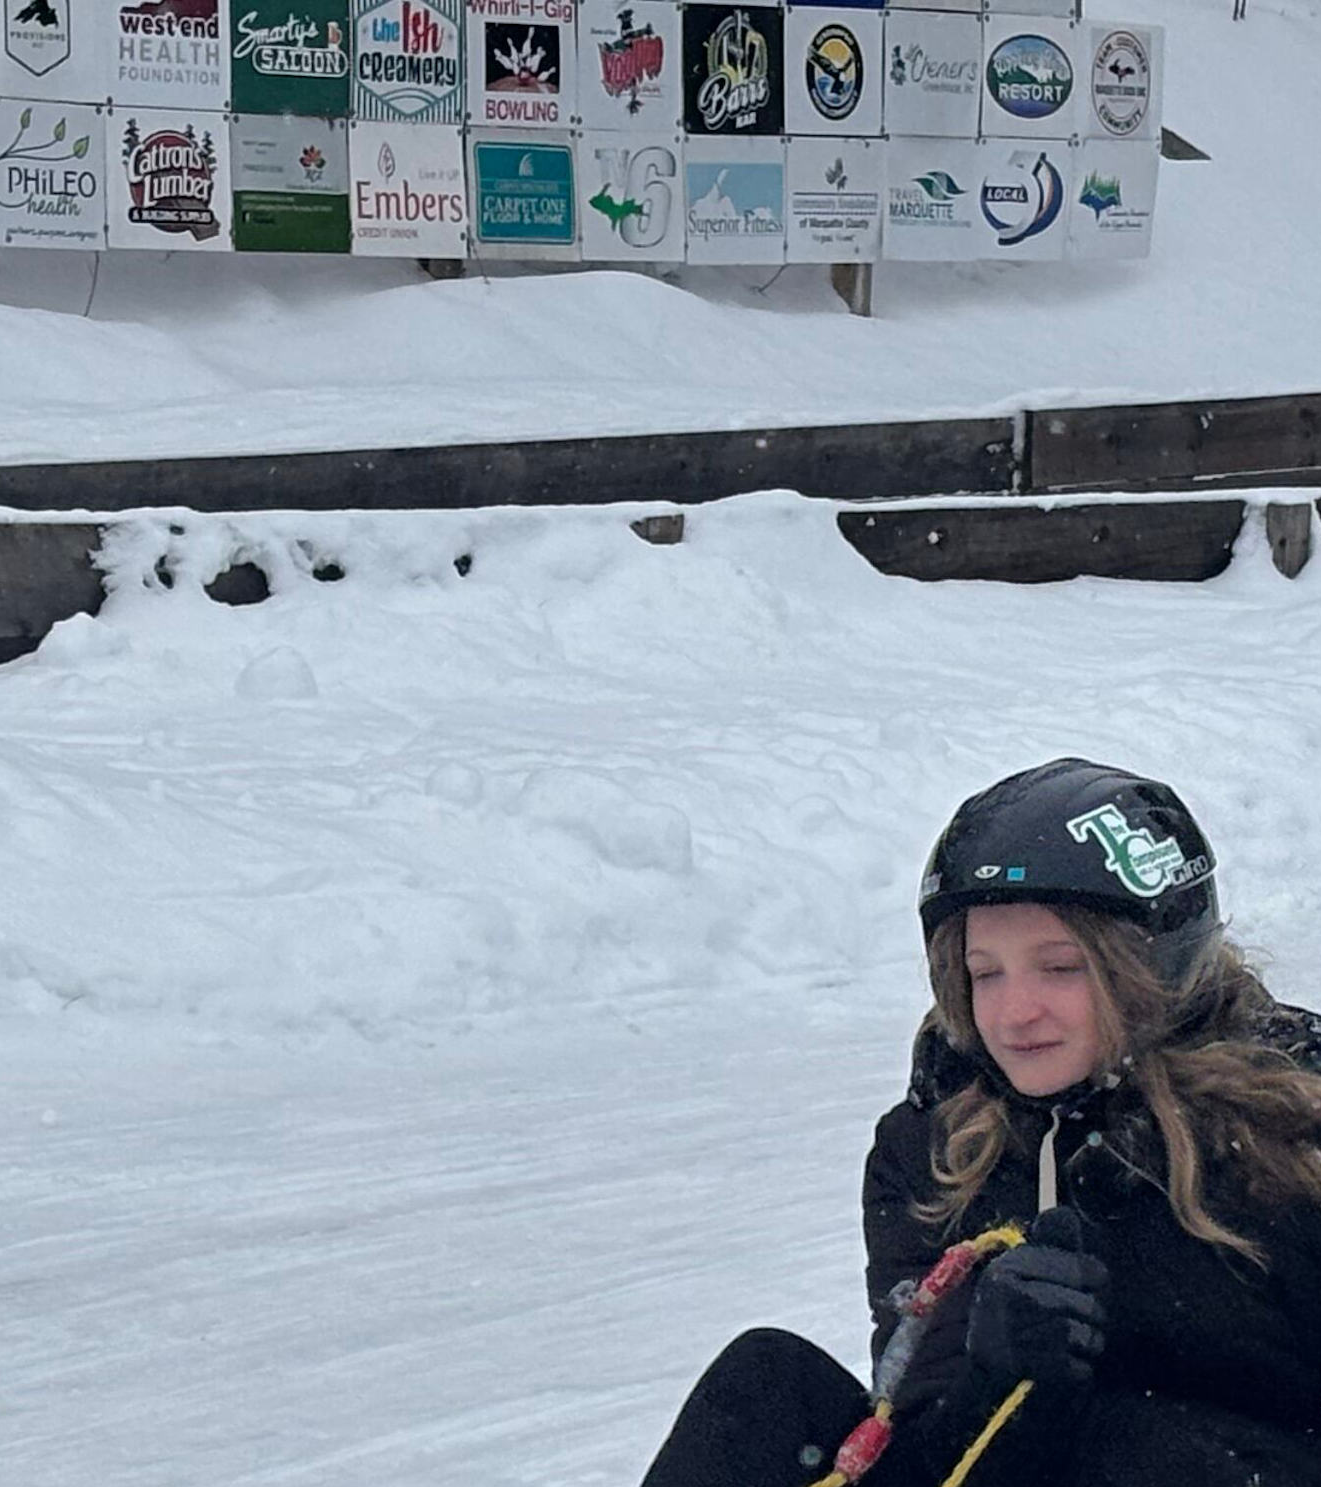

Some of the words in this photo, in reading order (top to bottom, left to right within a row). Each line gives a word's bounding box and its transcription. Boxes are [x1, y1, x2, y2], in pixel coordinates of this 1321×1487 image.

[120, 15, 176, 37] west
[180, 15, 220, 39] end
[233, 11, 319, 58] Smarty's
[372, 17, 400, 42] the
[119, 37, 221, 66] HEALTH
[261, 49, 341, 73] SALOON
[118, 65, 220, 86] FOUNDATION
[998, 83, 1064, 103] RESORT
[485, 99, 559, 122] BOWLING
[144, 168, 211, 208] Lumber
[986, 188, 1026, 201] LOCAL
[357, 180, 463, 223] Embers
[889, 203, 954, 219] MARQUETTE
